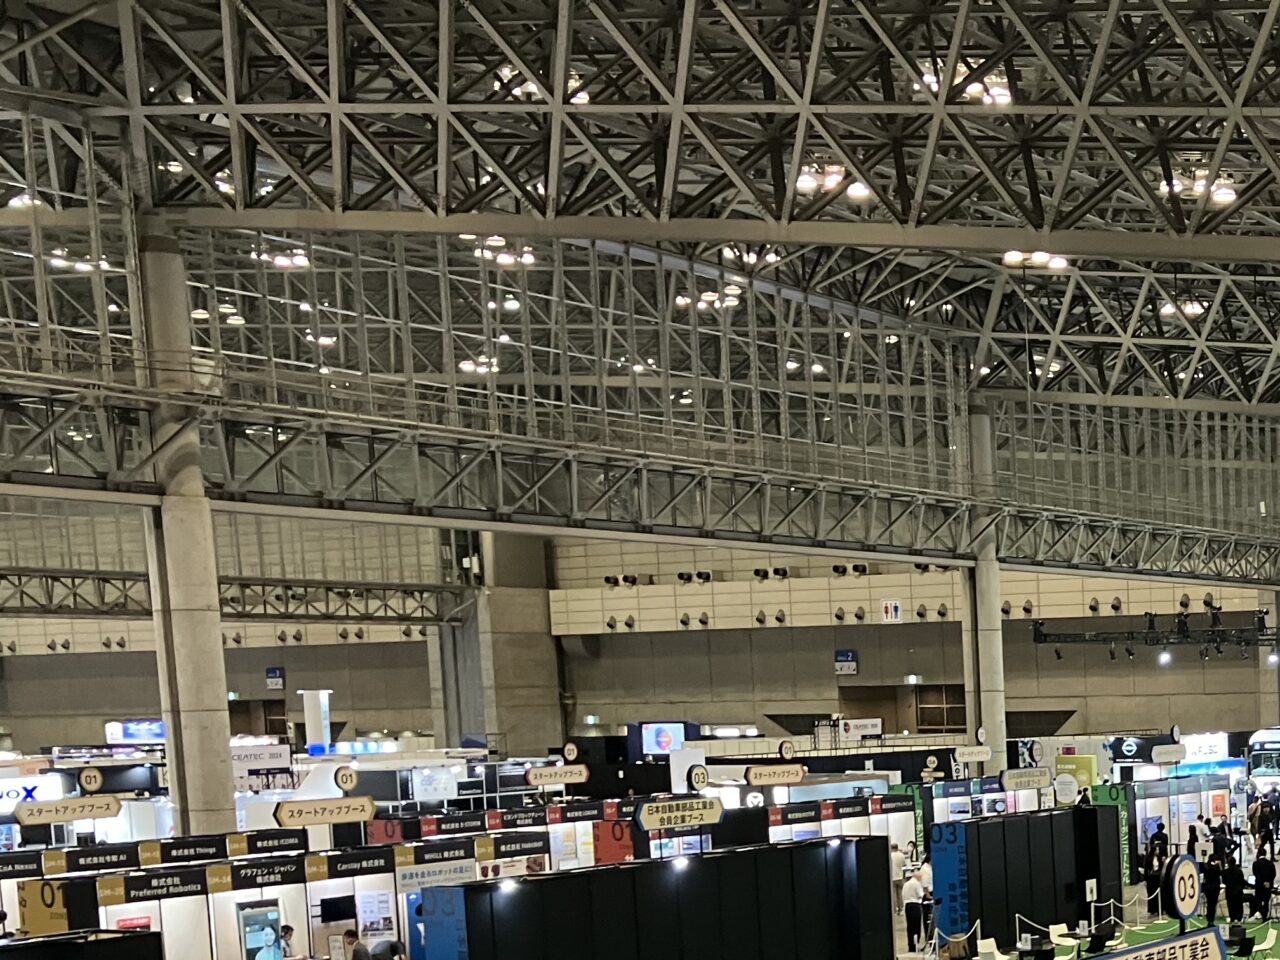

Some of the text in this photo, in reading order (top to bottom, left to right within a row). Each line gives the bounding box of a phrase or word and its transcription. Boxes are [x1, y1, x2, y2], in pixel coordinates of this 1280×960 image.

[84, 774, 98, 786] 01
[340, 772, 354, 784] 01
[693, 772, 706, 785] 03
[27, 803, 113, 818] スタートアップブース
[287, 805, 367, 819] スタートアップブース
[646, 801, 715, 816] 日本自動車部品工業会
[658, 814, 705, 826] 会員企業ブース
[930, 824, 958, 845] 03
[240, 864, 297, 878] グラフェン・ジャパン
[151, 876, 181, 887] 株式会社
[256, 874, 282, 884] 株式会社
[130, 883, 202, 898] Preferred Robotics
[1178, 873, 1197, 903] 03
